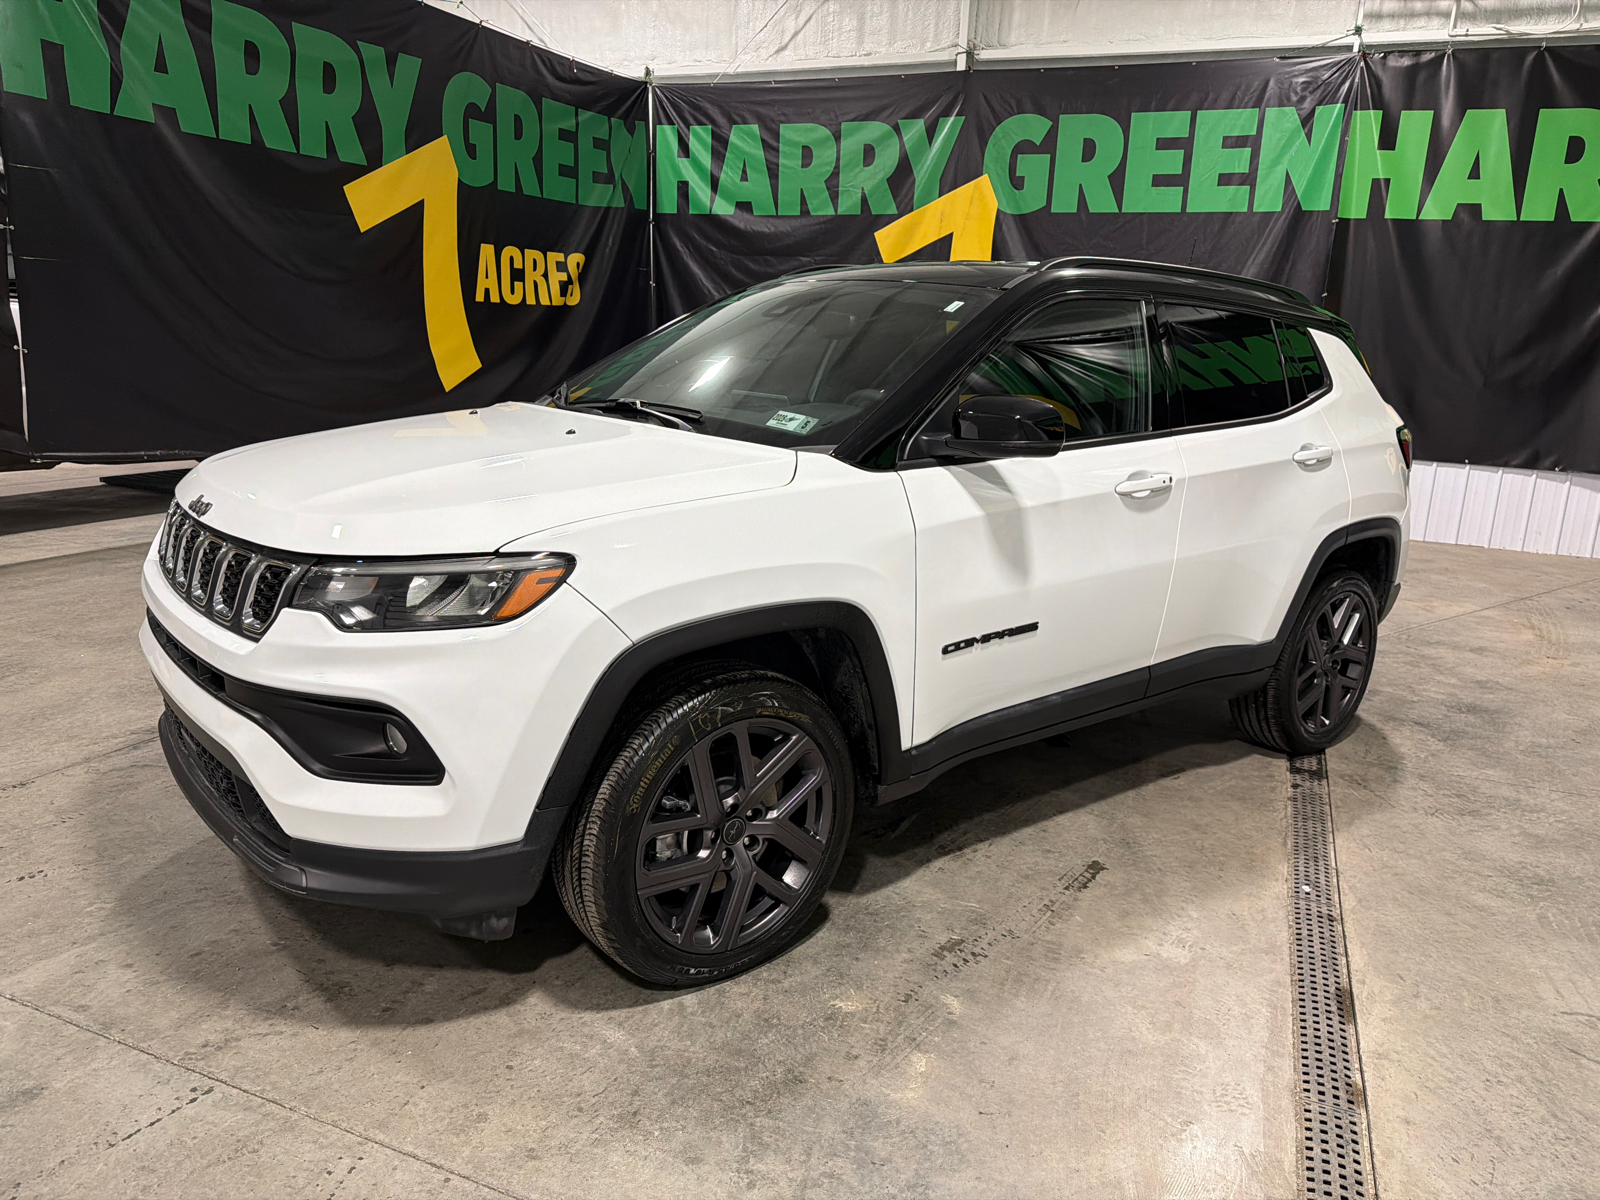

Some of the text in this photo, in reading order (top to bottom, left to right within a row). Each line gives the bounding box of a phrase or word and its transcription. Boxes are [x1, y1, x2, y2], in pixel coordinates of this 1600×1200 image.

[0, 0, 647, 211] HARRY GREEN
[656, 104, 1347, 217] HARRY GREEN
[343, 135, 586, 393] 7 ACRES
[941, 621, 1040, 656] COMPASS
